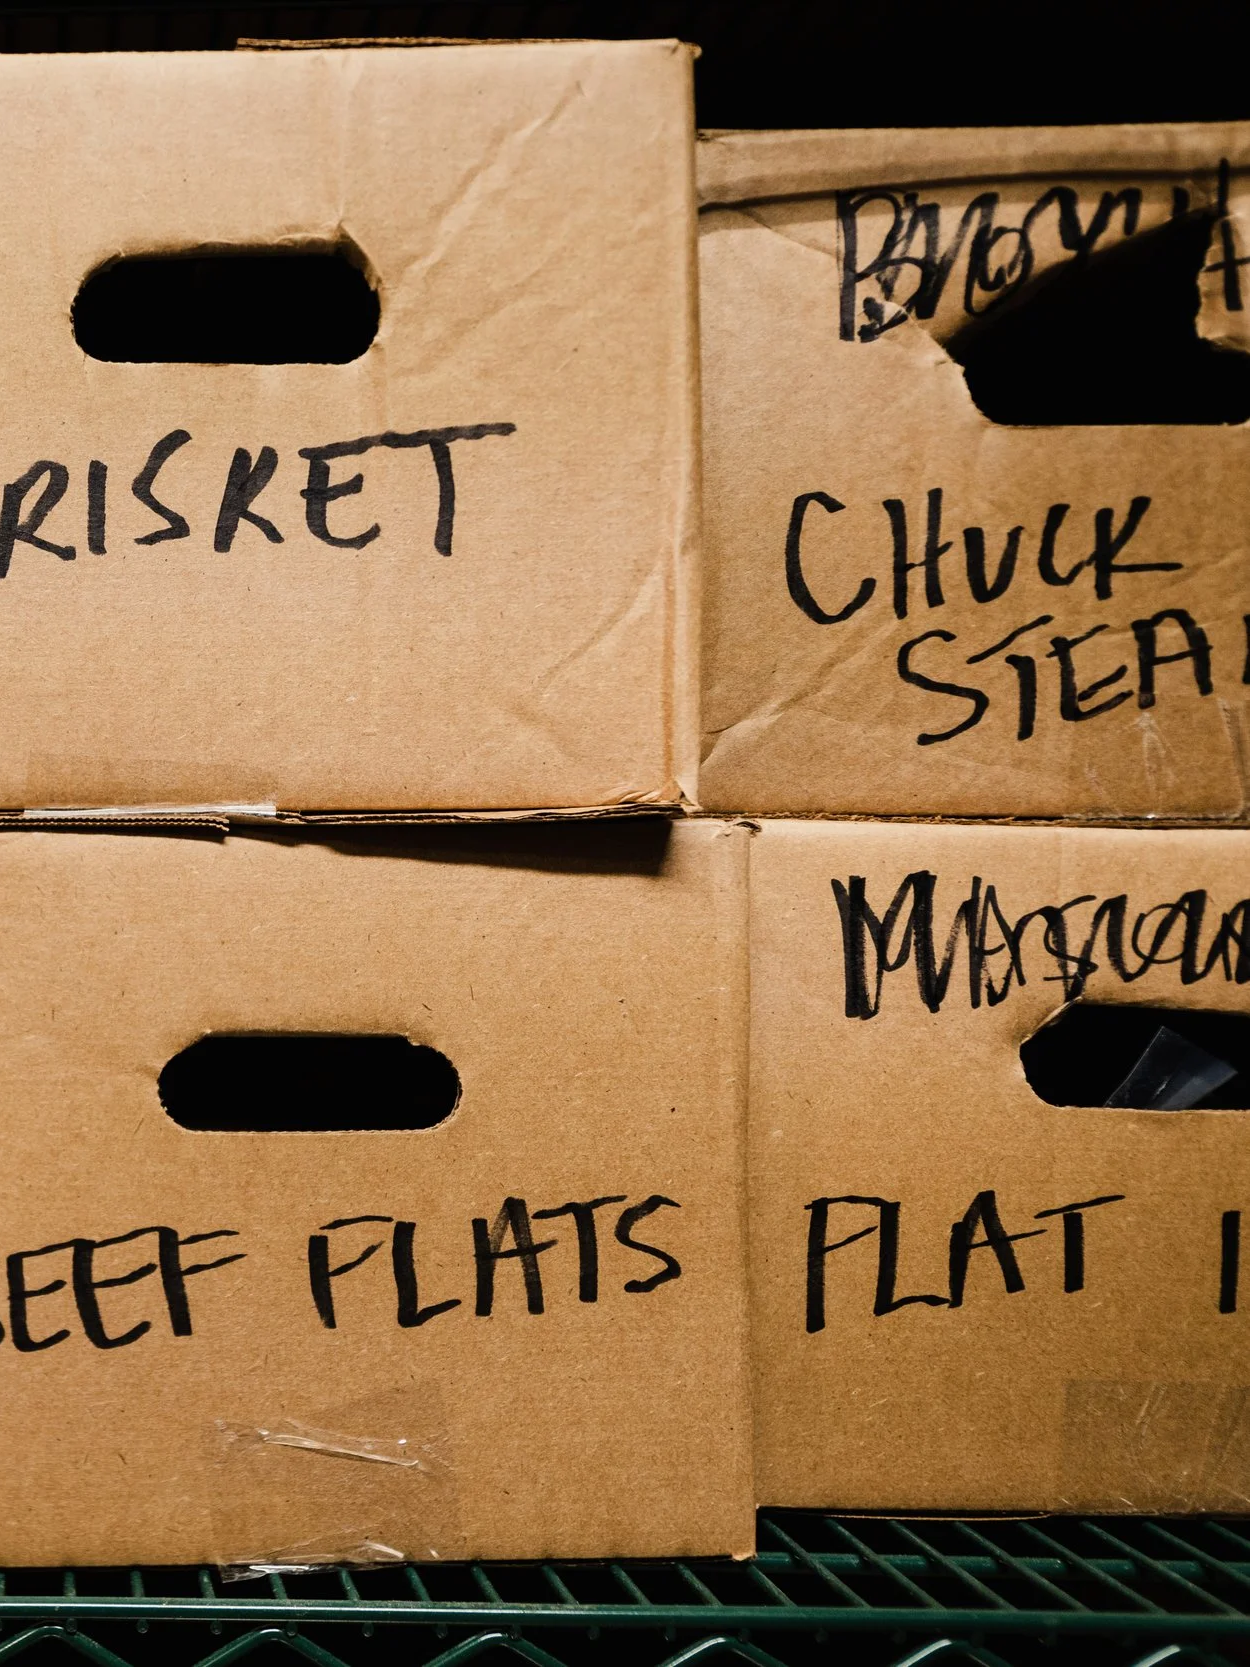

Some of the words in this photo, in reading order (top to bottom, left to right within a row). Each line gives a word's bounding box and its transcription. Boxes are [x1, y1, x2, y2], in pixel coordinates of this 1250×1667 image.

[784, 487, 1184, 625] CHUCK
[897, 608, 1250, 746] STEA
[307, 1193, 683, 1329] FLATS
[804, 1189, 1126, 1334] FLAT
